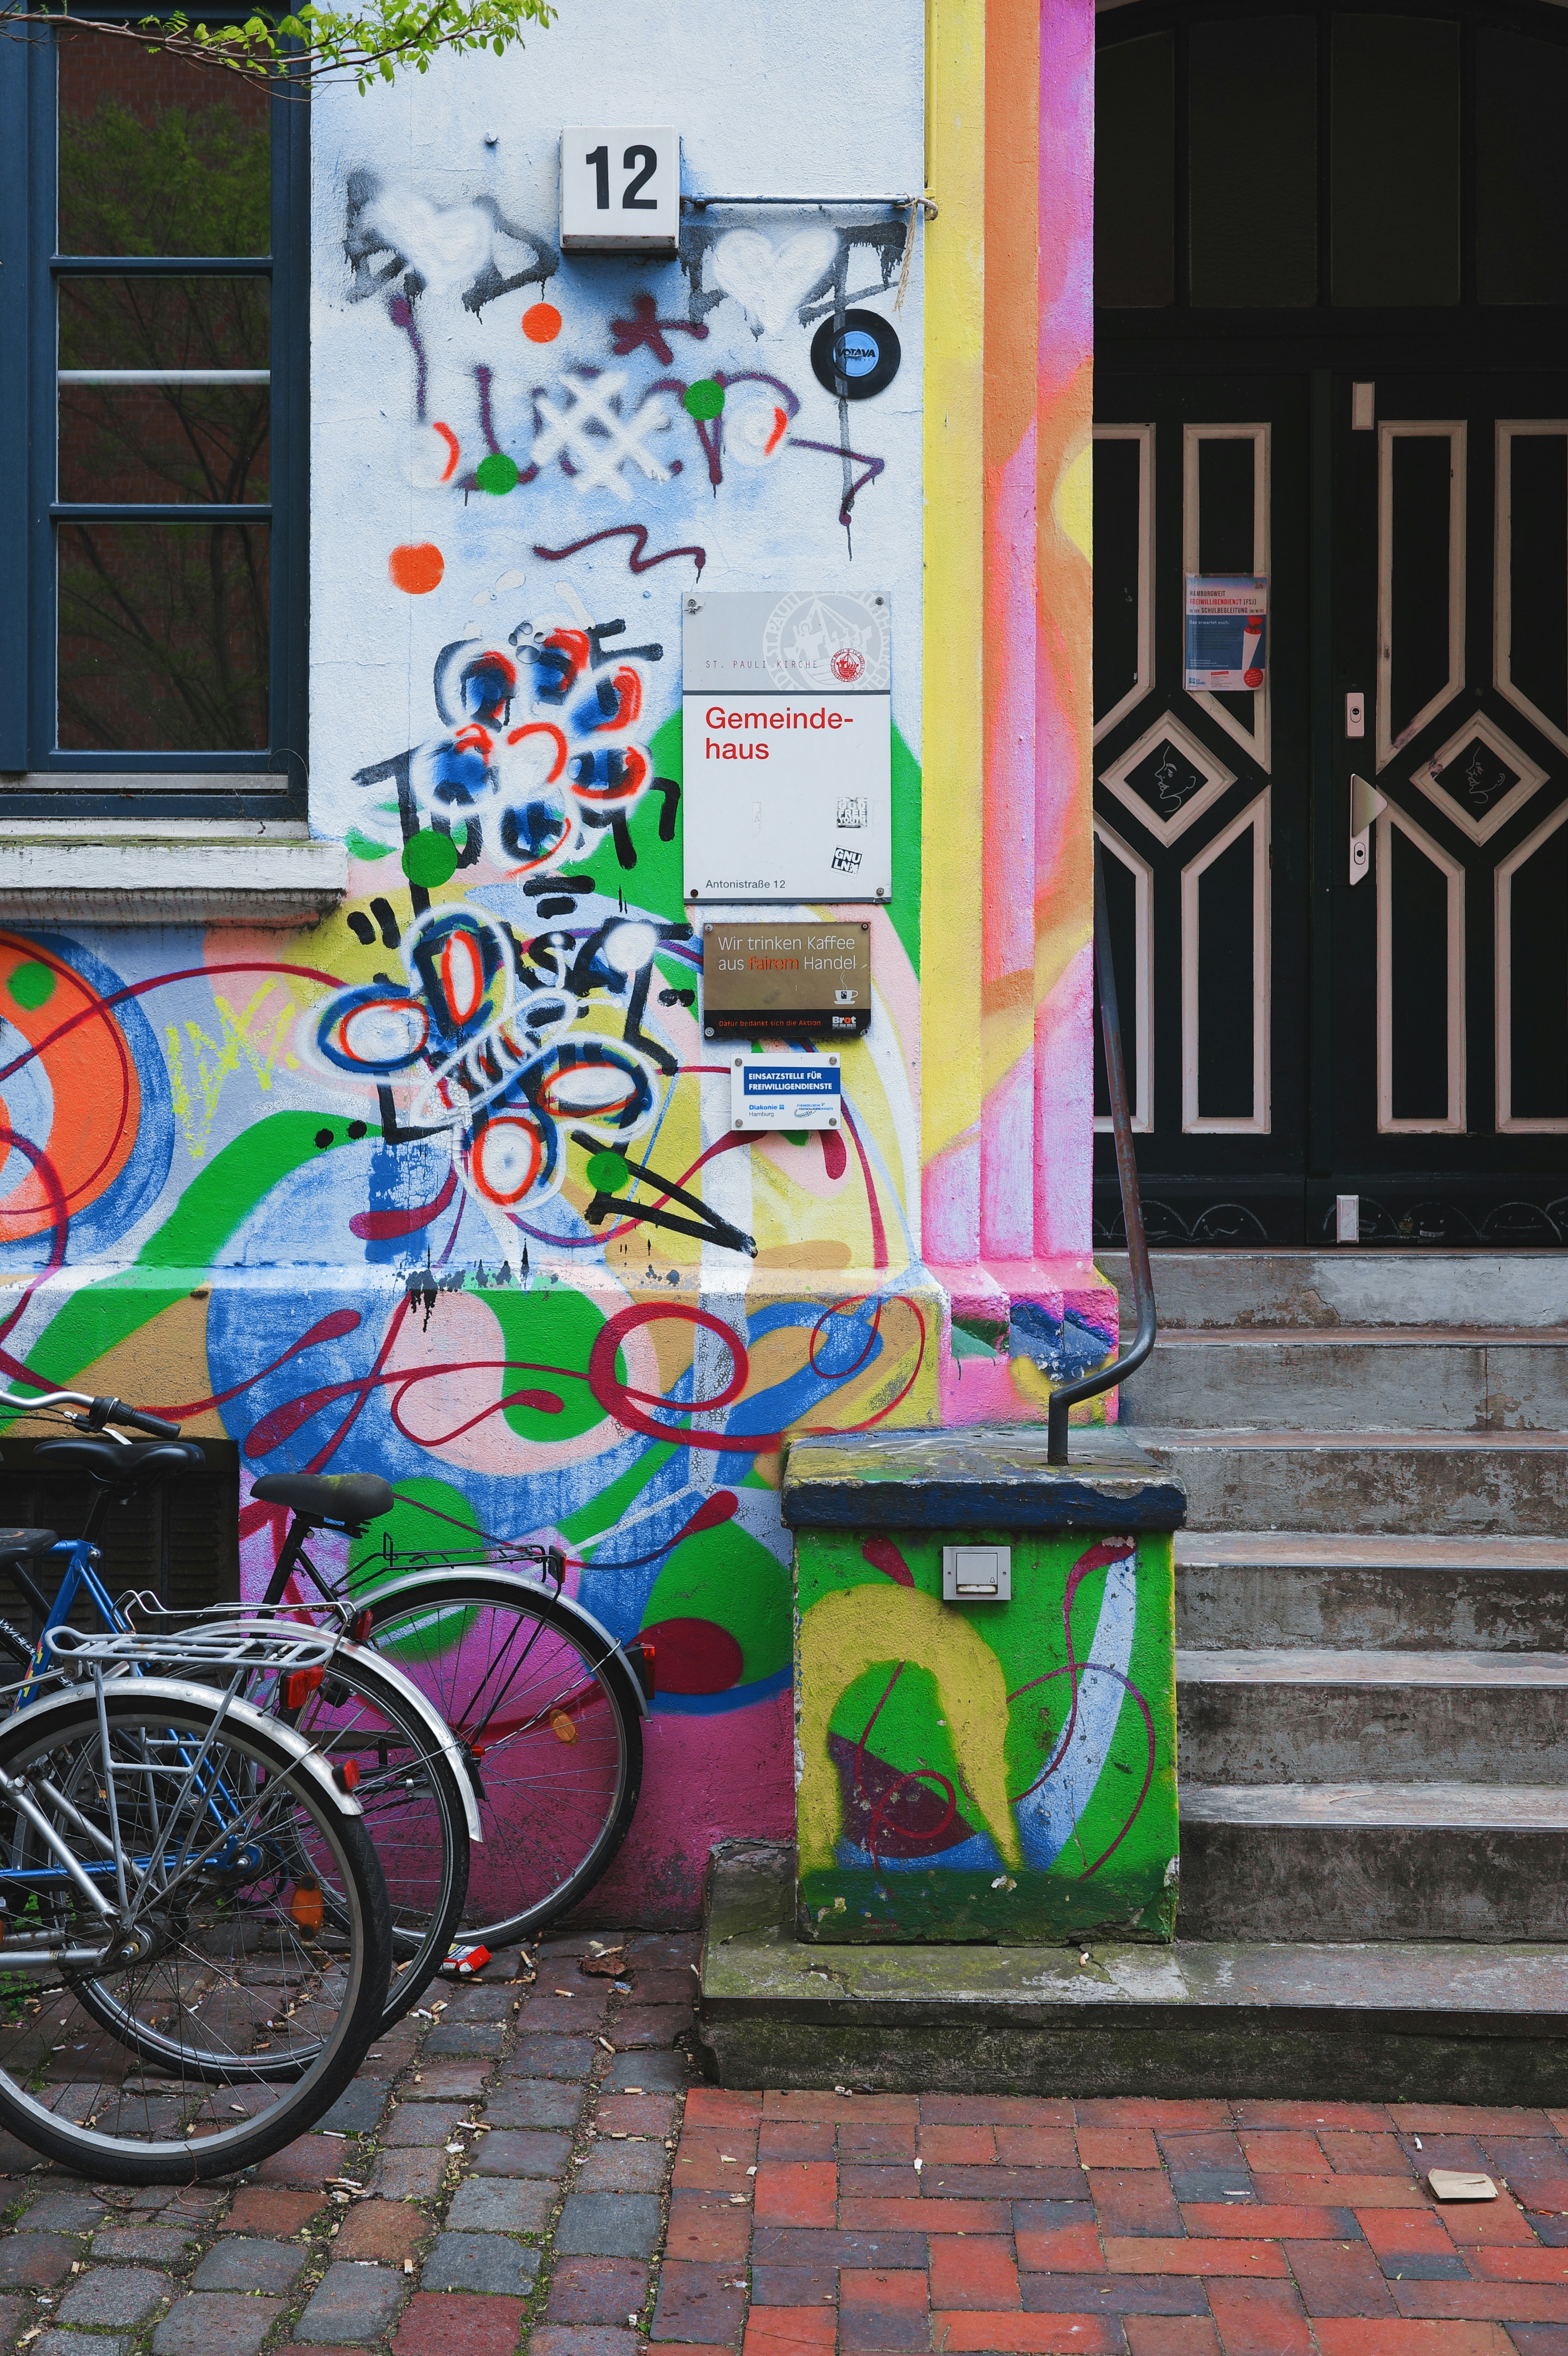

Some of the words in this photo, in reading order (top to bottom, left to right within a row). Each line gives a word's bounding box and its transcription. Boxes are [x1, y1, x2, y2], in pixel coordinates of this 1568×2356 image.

[586, 145, 657, 209] 12
[837, 348, 876, 358] VOTAVA
[706, 707, 853, 729] Gemeinde-
[706, 738, 769, 759] haus
[839, 801, 866, 810] GOD
[839, 810, 866, 818] FREE
[835, 849, 861, 863] GNU
[705, 880, 770, 889] Antonistraße
[774, 880, 785, 889] 12
[718, 936, 743, 950] Wir
[747, 936, 801, 950] trinken
[808, 935, 855, 950] Kaffee
[718, 958, 744, 970] aus
[748, 956, 799, 970] fairem
[804, 955, 856, 970] Handel
